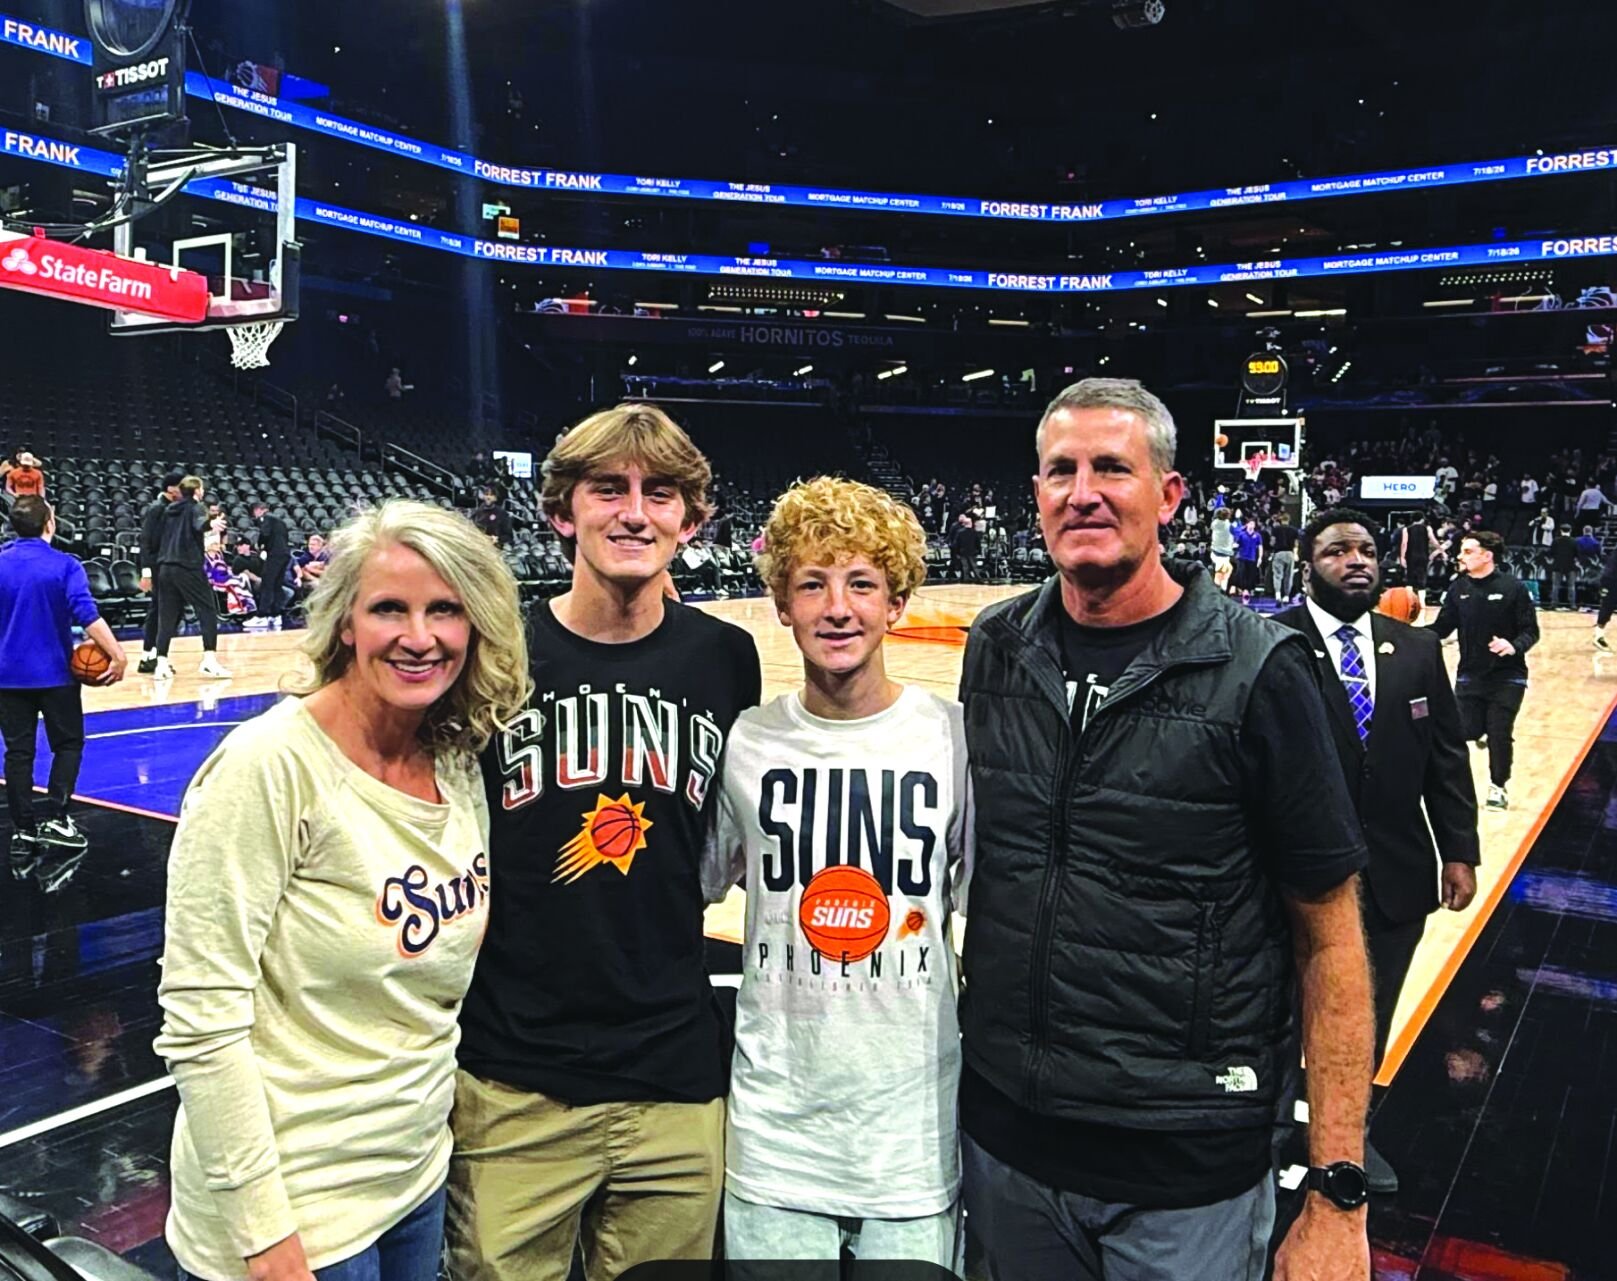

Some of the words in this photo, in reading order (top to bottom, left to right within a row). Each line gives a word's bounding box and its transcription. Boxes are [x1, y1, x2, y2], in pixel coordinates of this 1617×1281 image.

[4, 19, 80, 58] FRANK
[114, 58, 169, 86] TISSOT
[232, 85, 249, 98] THE
[250, 89, 278, 106] JESUS
[214, 92, 269, 115] GENERATION
[269, 107, 293, 122] TOUR
[315, 116, 358, 137] MORTGAGE
[359, 128, 394, 146] MATCHUP
[394, 138, 422, 154] CENTER
[4, 131, 80, 166] FRANK
[474, 160, 541, 185] FORREST
[545, 171, 602, 189] FRANK
[635, 177, 655, 187] TORI
[656, 178, 681, 188] KELLY
[1310, 180, 1361, 193] MORTGAGE
[1362, 175, 1407, 188] MATCHUP
[1408, 171, 1445, 183] CENTER
[232, 181, 249, 194] THE
[250, 185, 277, 200] JESUS
[712, 191, 763, 202] GENERATION
[764, 195, 786, 204] TOUR
[728, 183, 743, 191] THE
[745, 184, 771, 194] JESUS
[1226, 187, 1243, 196] THE
[1243, 185, 1271, 195] JESUS
[214, 190, 268, 209] GENERATION
[808, 193, 851, 203] MORTGAGE
[852, 195, 888, 205] MATCHUP
[889, 198, 920, 208] CENTER
[1134, 198, 1152, 207] TORI
[1152, 196, 1178, 206] KELLY
[1210, 195, 1263, 207] GENERATION
[1263, 192, 1287, 203] TOUR
[980, 202, 1048, 218] FORREST
[1051, 204, 1104, 219] FRANK
[315, 206, 359, 225] MORTGAGE
[359, 216, 393, 233] MATCHUP
[394, 225, 421, 239] CENTER
[474, 241, 547, 262] FORREST
[551, 249, 608, 265] FRANK
[641, 253, 661, 262] TORI
[661, 255, 688, 264] KELLY
[1322, 257, 1375, 270] MORTGAGE
[1375, 254, 1419, 265] MATCHUP
[1420, 251, 1459, 262] CENTER
[719, 266, 769, 276] GENERATION
[770, 268, 792, 277] TOUR
[735, 258, 750, 267] THE
[752, 258, 777, 268] JESUS
[1236, 263, 1254, 271] THE
[1255, 260, 1282, 270] JESUS
[814, 266, 858, 277] MORTGAGE
[859, 268, 895, 278] MATCHUP
[896, 271, 927, 281] CENTER
[988, 273, 1056, 289] FORREST
[1059, 274, 1113, 289] FRANK
[1143, 271, 1162, 280] TORI
[1163, 268, 1189, 278] KELLY
[1220, 270, 1273, 283] GENERATION
[1274, 268, 1298, 278] TOUR
[740, 326, 844, 347] HORNITOS
[1383, 483, 1417, 492] HERO
[500, 694, 722, 813] SUNS
[758, 767, 938, 898] SUNS
[758, 942, 930, 979] PHOENIX
